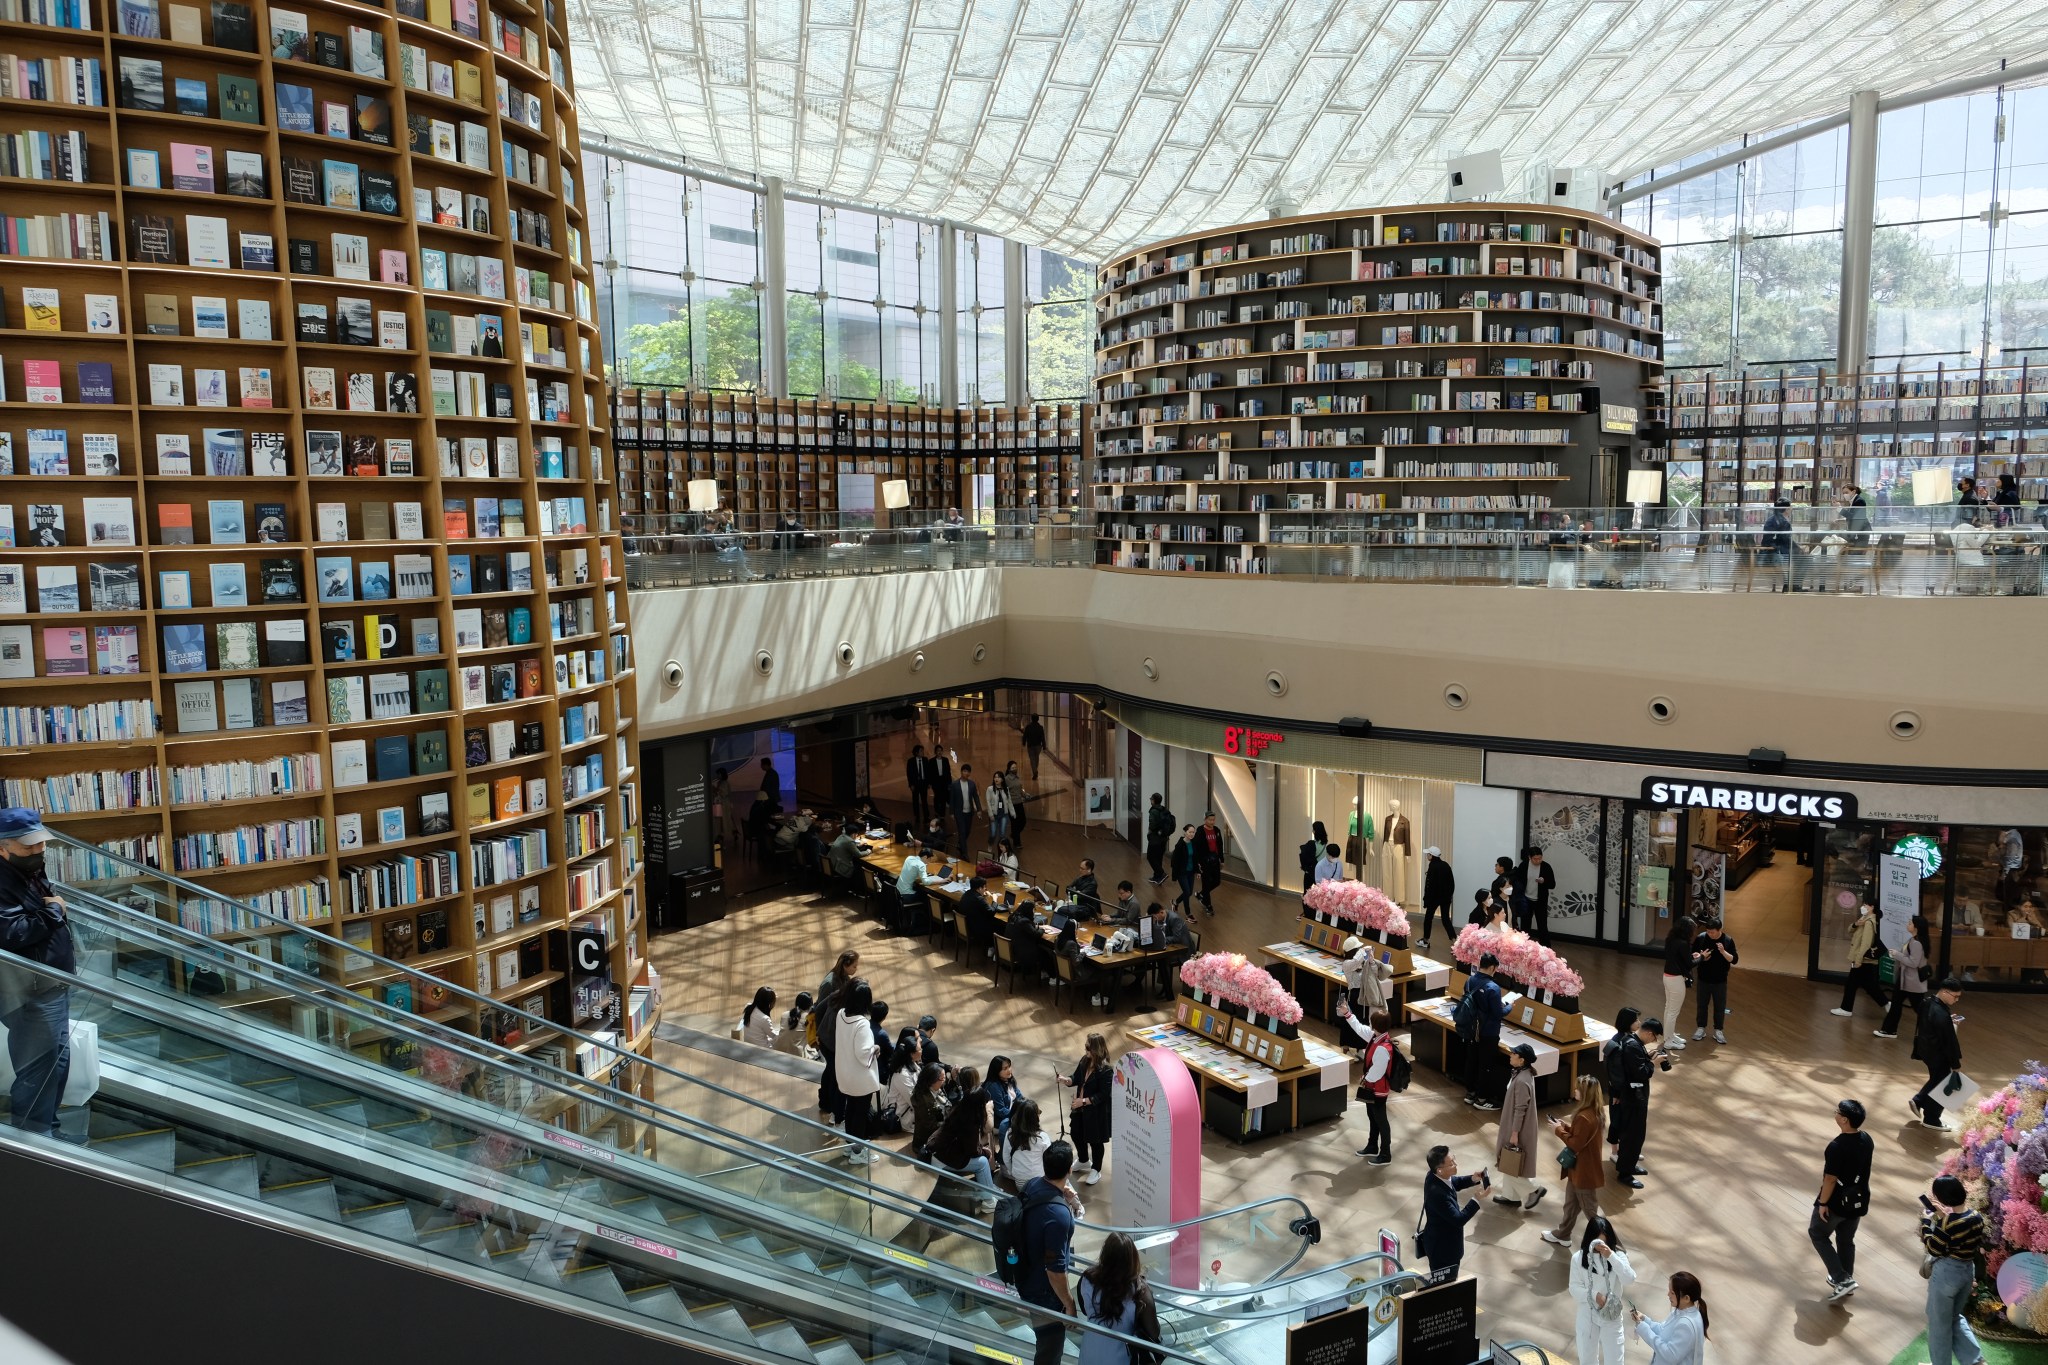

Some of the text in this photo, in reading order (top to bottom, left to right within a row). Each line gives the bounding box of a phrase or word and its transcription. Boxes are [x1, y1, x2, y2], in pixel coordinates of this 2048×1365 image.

[302, 322, 326, 334] 군함도
[384, 322, 404, 330] JUSTICE
[838, 414, 846, 426] F
[1608, 406, 1638, 422] BILLY ANGEL
[390, 447, 400, 461] 7
[380, 623, 396, 649] D
[174, 656, 202, 666] LAYOUTS
[181, 692, 210, 701] SYSTEM
[182, 700, 211, 708] OFFICE
[1252, 731, 1284, 742] seconds
[1651, 782, 1843, 819] STARBUCKS
[1867, 810, 1893, 819] 스타벅스
[1891, 870, 1908, 882] 입구
[1891, 881, 1909, 889] ENTER
[578, 938, 600, 970] C
[395, 1042, 418, 1055] PATH
[1126, 1078, 1141, 1101] 시가
[1126, 1089, 1156, 1124] 불러온 봄
